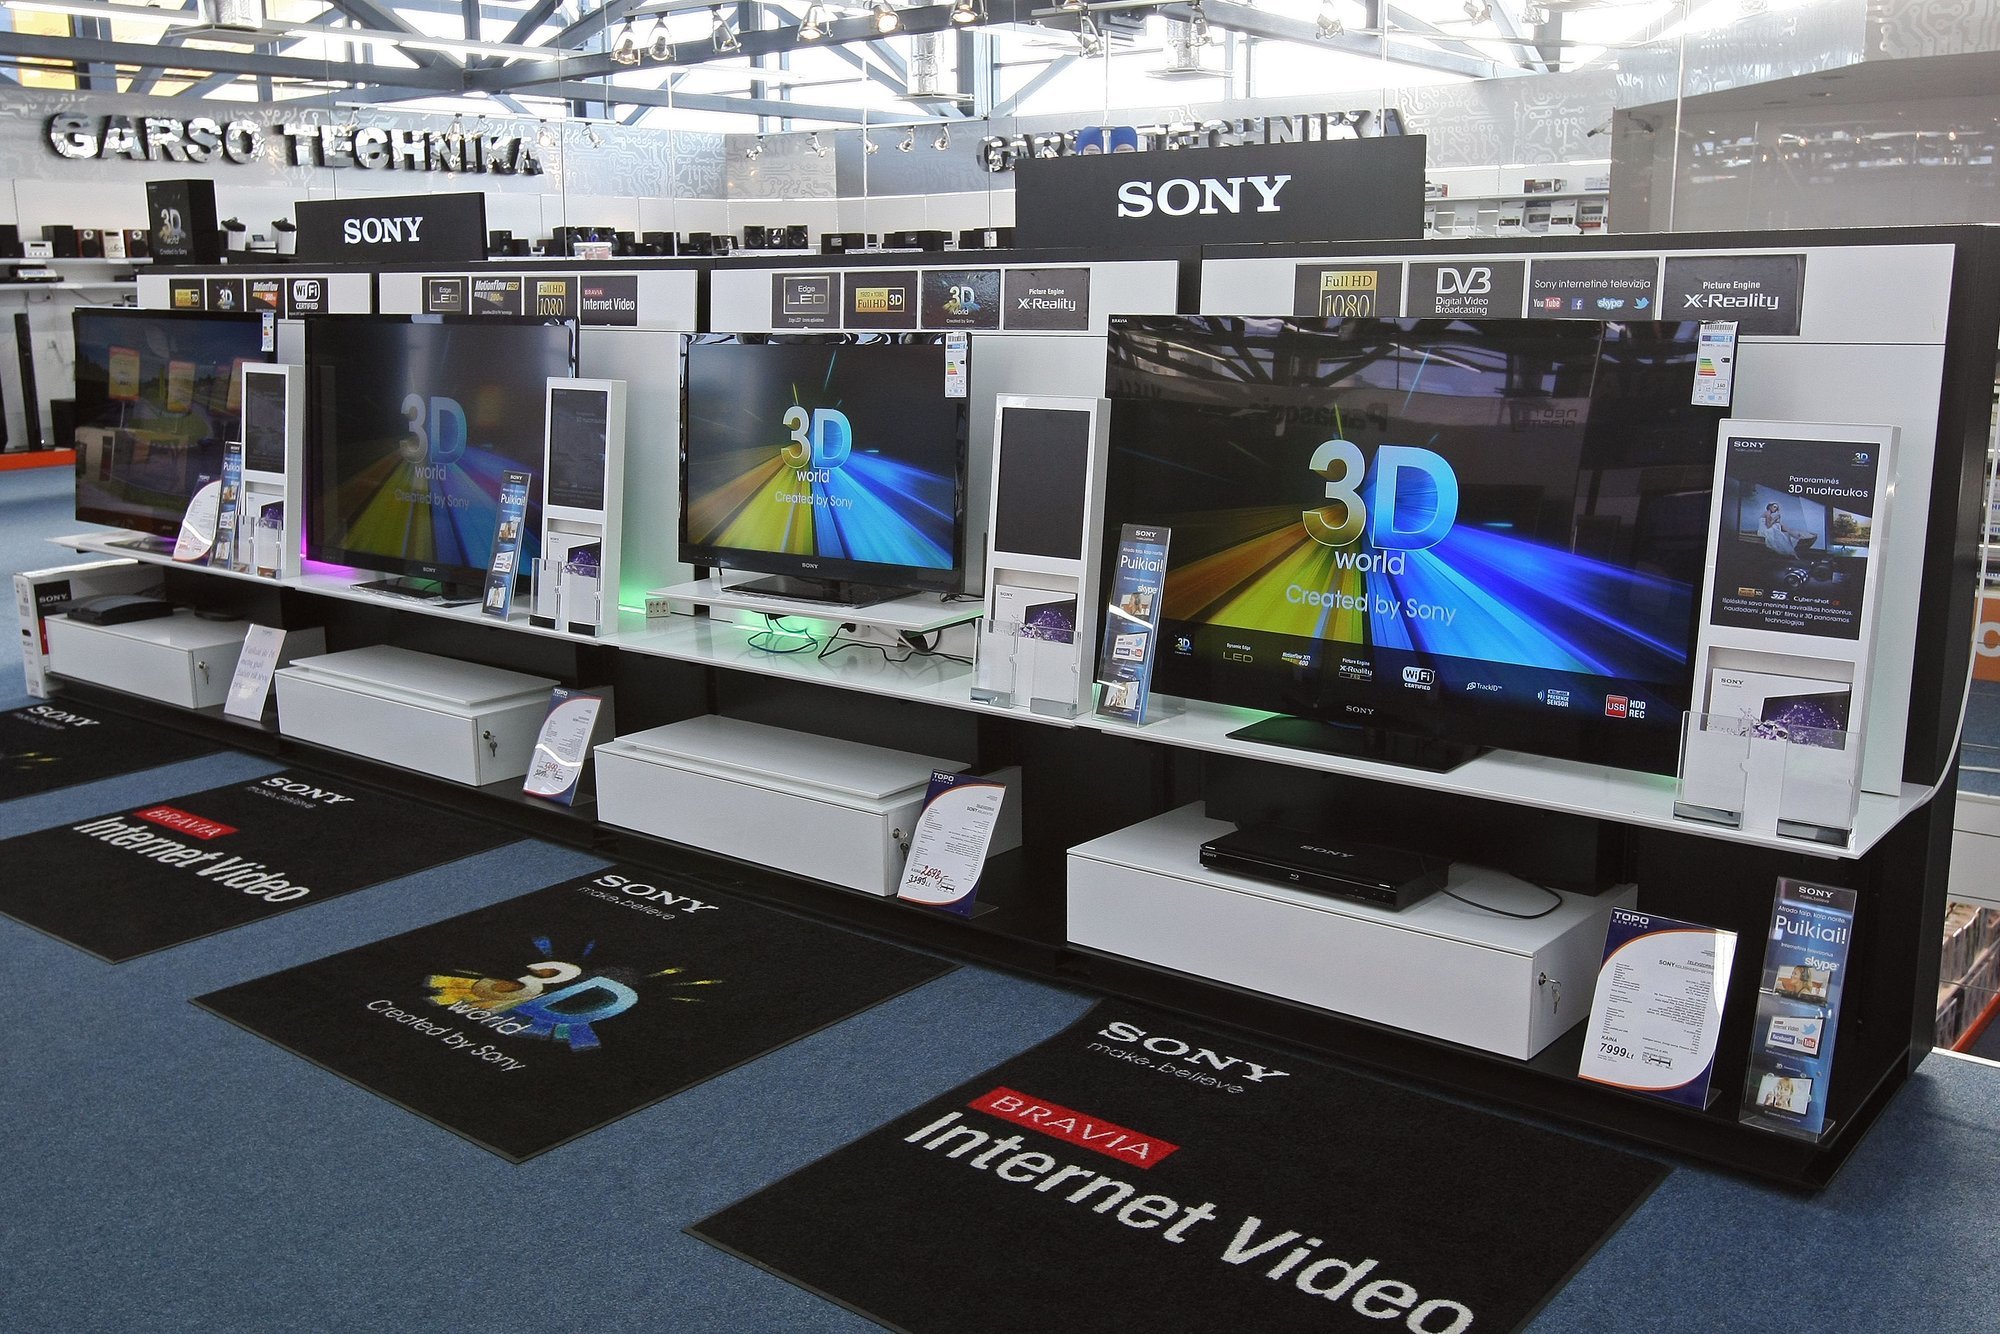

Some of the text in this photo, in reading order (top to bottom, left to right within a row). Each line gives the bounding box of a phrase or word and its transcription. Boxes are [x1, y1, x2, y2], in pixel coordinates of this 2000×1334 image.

[44, 112, 544, 175] GARSO TECHNIKA
[1117, 175, 1292, 218] SONY
[160, 208, 182, 233] 3D
[344, 216, 423, 244] SONY
[475, 280, 506, 290] Motionflow
[1324, 276, 1372, 288] Full HD
[1436, 268, 1492, 294] DVB
[1534, 278, 1651, 291] Sony internetinė televizija
[1702, 280, 1760, 291] Picture Engine
[220, 289, 232, 301] 3D
[439, 286, 452, 295] Edge
[539, 284, 564, 294] Full HD
[798, 285, 816, 294] Edge
[1028, 288, 1064, 297] Picture Engine
[432, 294, 459, 304] LED
[788, 294, 826, 304] LED
[889, 294, 902, 306] 3D
[948, 286, 975, 308] 3D
[1436, 296, 1488, 308] Digital Video
[1596, 297, 1624, 310] skype
[1684, 294, 1779, 310] X-Reality
[540, 298, 563, 316] 1080
[583, 298, 635, 310] Internet Video
[858, 300, 886, 308] Full HD
[1018, 298, 1076, 312] X-Reality
[1324, 294, 1370, 317] 1080
[1436, 304, 1488, 316] Broadcasting
[400, 394, 468, 464] 3D
[781, 406, 852, 469] 3D
[1734, 440, 1766, 448] SONY
[414, 464, 446, 480] world
[796, 469, 830, 483] world
[1789, 476, 1840, 484] Panoraminės
[1302, 439, 1460, 551] 3D
[1788, 484, 1869, 498] 3D nuotraukos
[395, 489, 470, 511] Created by Sony
[500, 492, 526, 506] Puikiai!
[774, 490, 853, 510] Created by Sony
[1135, 530, 1157, 538] SONY
[802, 562, 818, 570] SONY
[1120, 554, 1164, 572] Puikiai!
[1334, 550, 1406, 576] world
[1137, 584, 1158, 595] skype
[40, 594, 66, 603] SONY
[1793, 595, 1830, 604] Cyber-shot
[1286, 584, 1457, 627] Created by Sony
[1724, 606, 1758, 614] naudodami
[1814, 614, 1850, 624] panoramos
[1764, 617, 1805, 627] technologijas
[1177, 638, 1190, 648] 3D
[1222, 652, 1254, 663] LED
[1340, 664, 1372, 676] X-Reality
[1404, 682, 1430, 690] CERTIFIED
[1720, 678, 1744, 686] SONY
[554, 688, 568, 696] TOPO
[1346, 704, 1374, 715] SONY
[1547, 700, 1568, 708] SENSOR
[1608, 702, 1626, 712] USB
[1630, 700, 1646, 710] HDD
[27, 706, 100, 726] SONY
[1629, 710, 1645, 718] REC
[934, 772, 954, 782] TOPO
[262, 776, 354, 804] SONY
[146, 808, 222, 836] BRAVIA
[1300, 845, 1356, 858] SONY
[73, 816, 310, 902] Internet Video
[593, 874, 719, 914] SONY
[1798, 886, 1834, 898] SONY
[577, 886, 676, 921] make.believe
[1614, 911, 1650, 925] TOPO
[1778, 906, 1798, 914] Atrodo
[1813, 912, 1826, 920] kaip
[1612, 918, 1648, 930] CENTRAS
[1775, 914, 1847, 944] Puikiai!
[1658, 960, 1675, 968] SONY
[1804, 956, 1838, 971] skype
[470, 960, 638, 1024] 3D
[447, 1000, 532, 1037] world
[366, 999, 526, 1072] Created by Sony
[1600, 1035, 1618, 1043] KAINA
[1096, 1020, 1290, 1083] SONY
[1085, 1041, 1245, 1096] make.believe
[989, 1094, 1152, 1161] BRAVIA
[903, 1110, 1475, 1334] Internet Video
